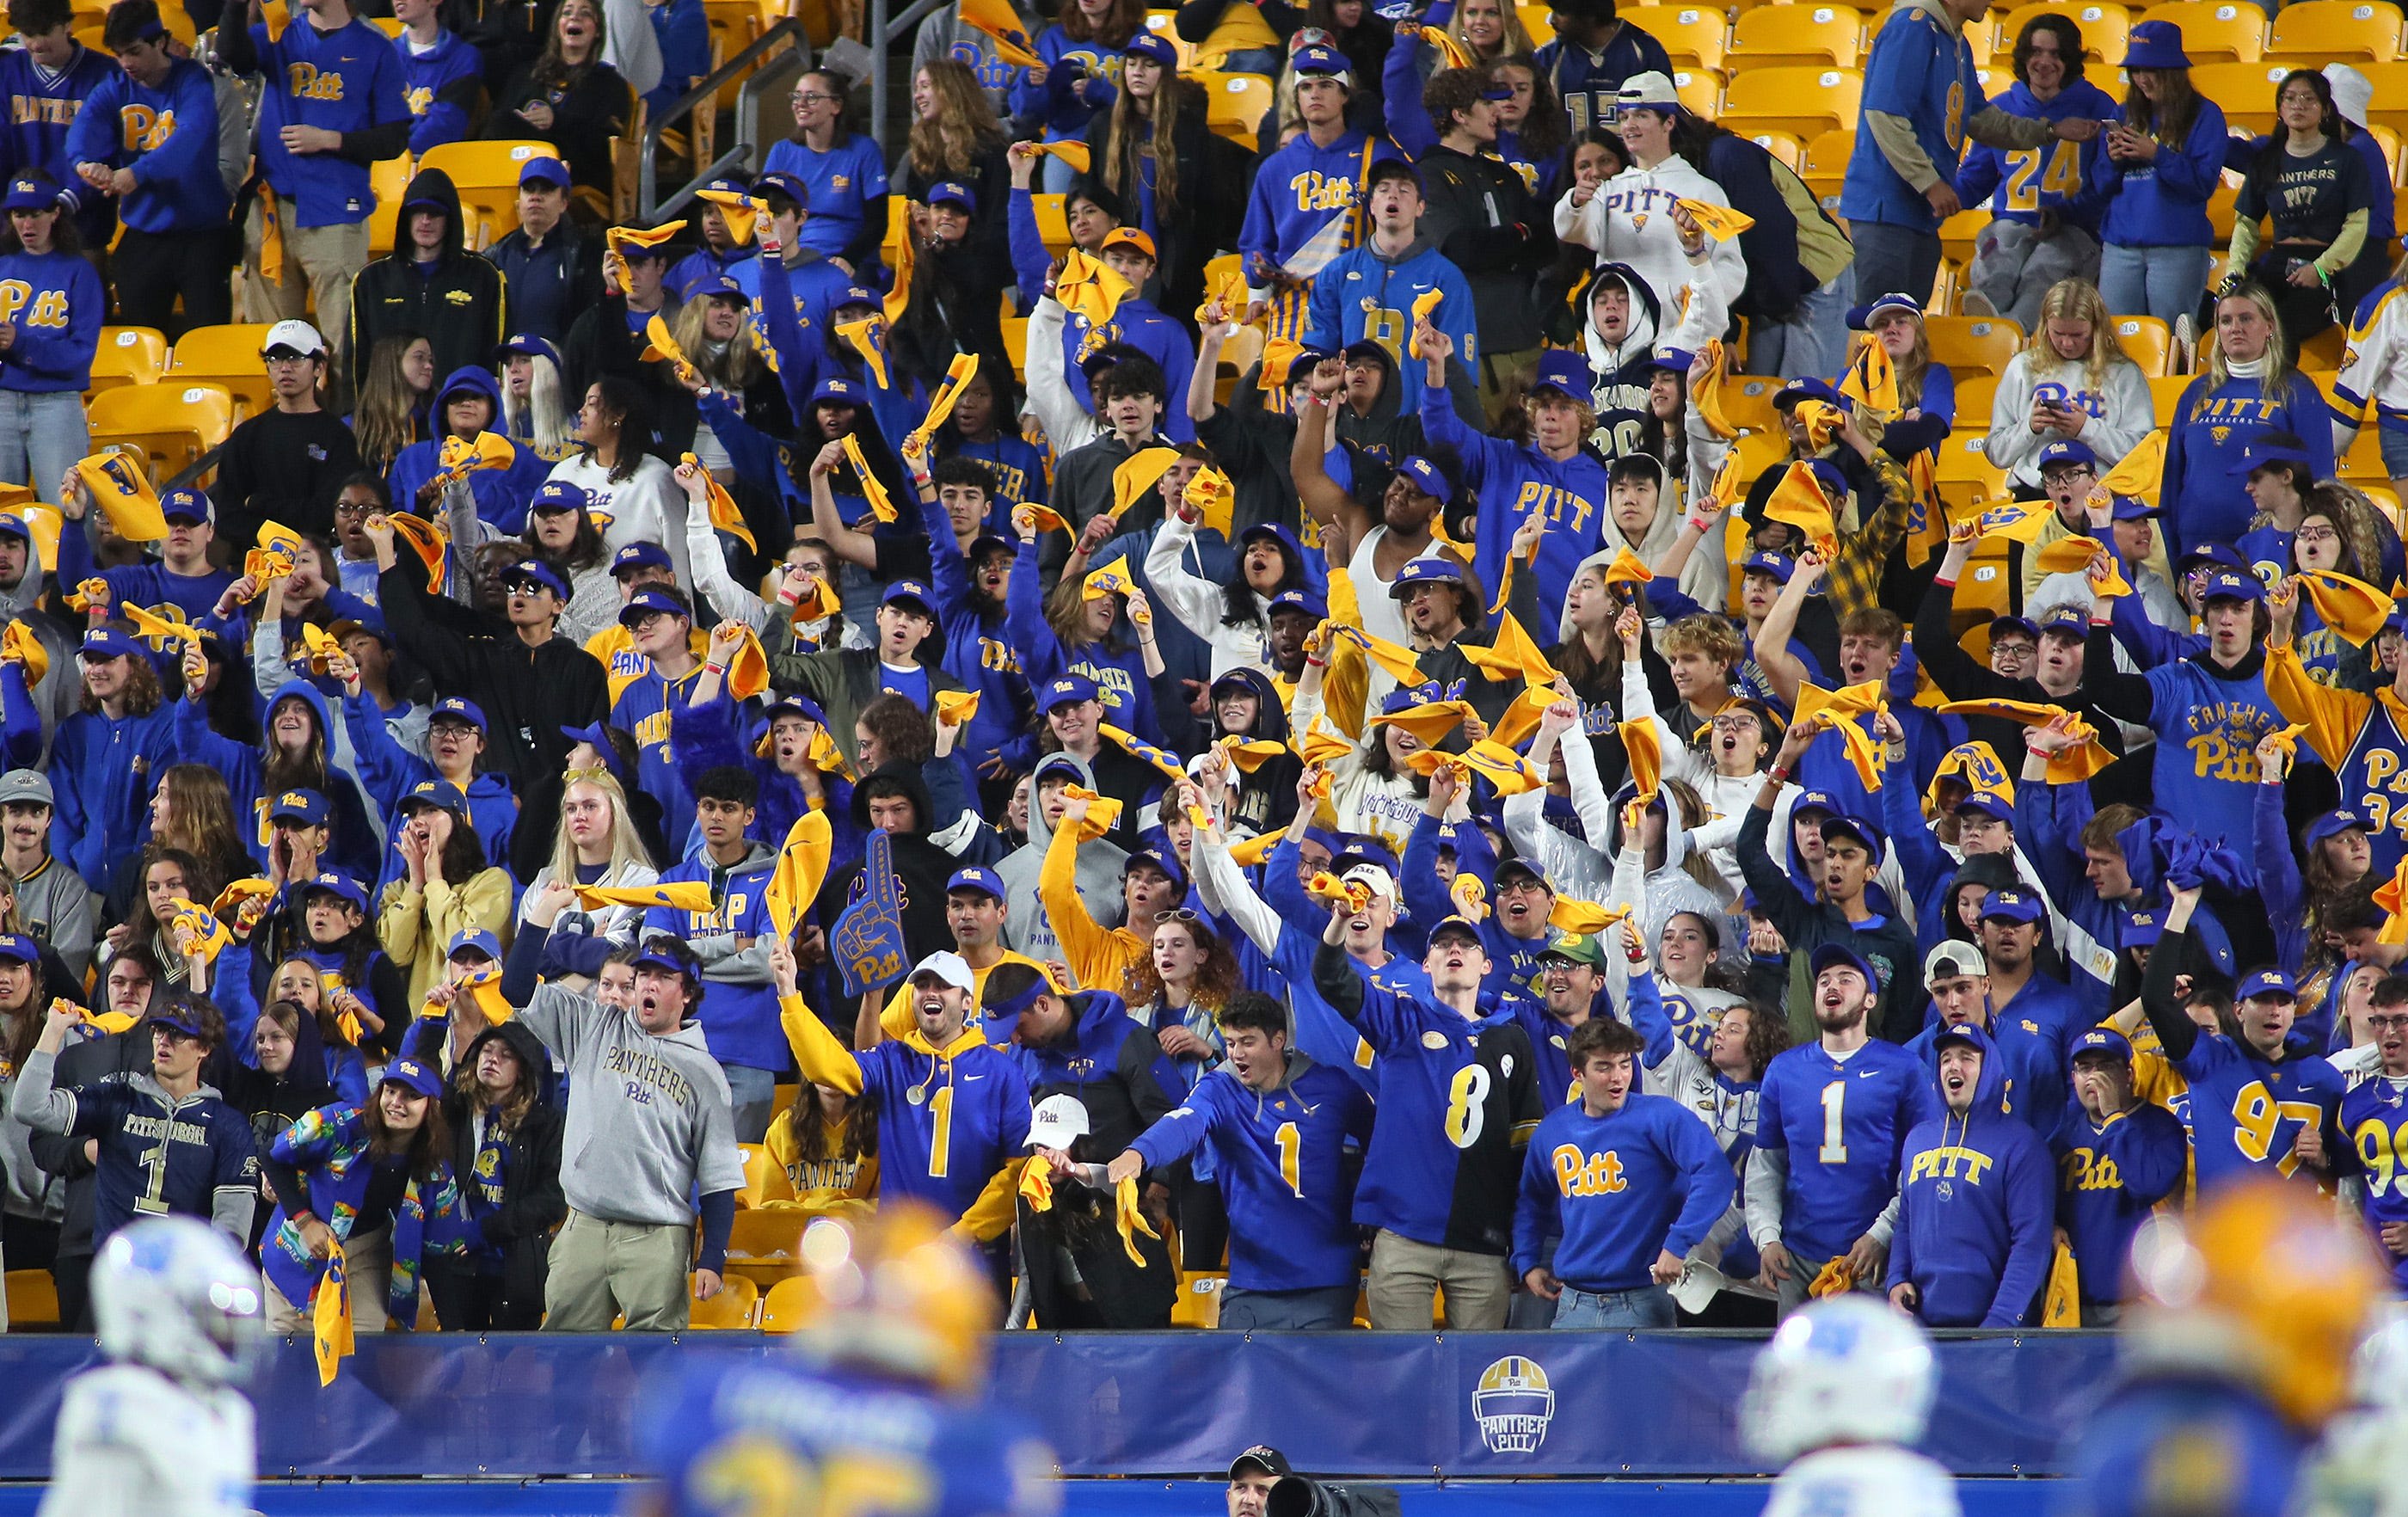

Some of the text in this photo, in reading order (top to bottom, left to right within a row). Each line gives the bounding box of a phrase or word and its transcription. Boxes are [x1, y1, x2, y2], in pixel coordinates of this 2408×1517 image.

[2087, 10, 2094, 19] 8
[2222, 9, 2229, 17] 9
[2357, 8, 2370, 17] 10
[1309, 49, 1329, 60] Pitt
[289, 62, 344, 101] Pitt
[2275, 71, 2282, 79] 9
[1945, 82, 1964, 150] 8
[2005, 139, 2082, 212] 24
[2277, 169, 2336, 183] ANTHERS
[16, 181, 35, 192] Pitt
[1290, 170, 1354, 212] Pitt
[1606, 187, 1680, 216] PITT
[2283, 187, 2317, 207] PITT
[0, 279, 69, 328] Ptt
[2123, 323, 2136, 333] 10
[828, 379, 847, 392] Pitt
[1751, 384, 1758, 393] 8
[2189, 397, 2281, 421] PITT
[1970, 440, 1982, 450] 10
[2049, 443, 2067, 454] Pitt
[1414, 458, 1432, 475] Pitt
[543, 486, 562, 496] Pitt
[586, 488, 613, 506] Pitt
[173, 492, 194, 504] Pitt
[1514, 482, 1593, 533] PITT
[621, 547, 641, 559] Pitt
[1762, 553, 1781, 566] Pitt
[1402, 564, 1421, 579] Pitt
[1980, 570, 1991, 579] 11
[2221, 574, 2240, 587] Pitt
[901, 582, 922, 595] Pitt
[1284, 591, 1304, 602] Pitt
[2060, 611, 2079, 623] Pitt
[90, 629, 108, 640] Pitt
[1054, 681, 1074, 693] Pitt
[445, 697, 465, 709] Pitt
[1410, 691, 1429, 703] Pitt
[1576, 697, 1615, 735] itt
[2364, 749, 2408, 790] Pi
[282, 792, 308, 808] Pitt
[1806, 792, 1827, 803] Pitt
[1974, 792, 1992, 803] Pitt
[1439, 826, 1457, 837] Pitt
[320, 872, 339, 883] Pitt
[961, 869, 982, 880] Pitt
[2132, 912, 2153, 925] Pitt
[464, 929, 481, 940] P
[852, 950, 903, 986] Pitt
[2261, 973, 2284, 985] Pitt
[2085, 1033, 2106, 1043] Pitt
[400, 1061, 419, 1076] Pitt
[604, 1046, 691, 1108] PANTHERS
[626, 1082, 651, 1105] Pitt
[1445, 1064, 1490, 1148] 8
[1039, 1109, 1060, 1124] Pitt
[1820, 1081, 1847, 1163] 1
[929, 1086, 954, 1177] 1
[2233, 1080, 2322, 1179] 97
[1275, 1122, 1305, 1198] 1
[1908, 1146, 1993, 1186] PITT
[1551, 1144, 1628, 1197] Pitt
[2064, 1147, 2123, 1191] Pitt
[135, 1147, 171, 1217] 1
[1198, 1282, 1211, 1291] 12
[1481, 1416, 1547, 1434] PANTHER
[1497, 1434, 1529, 1449] PITT
